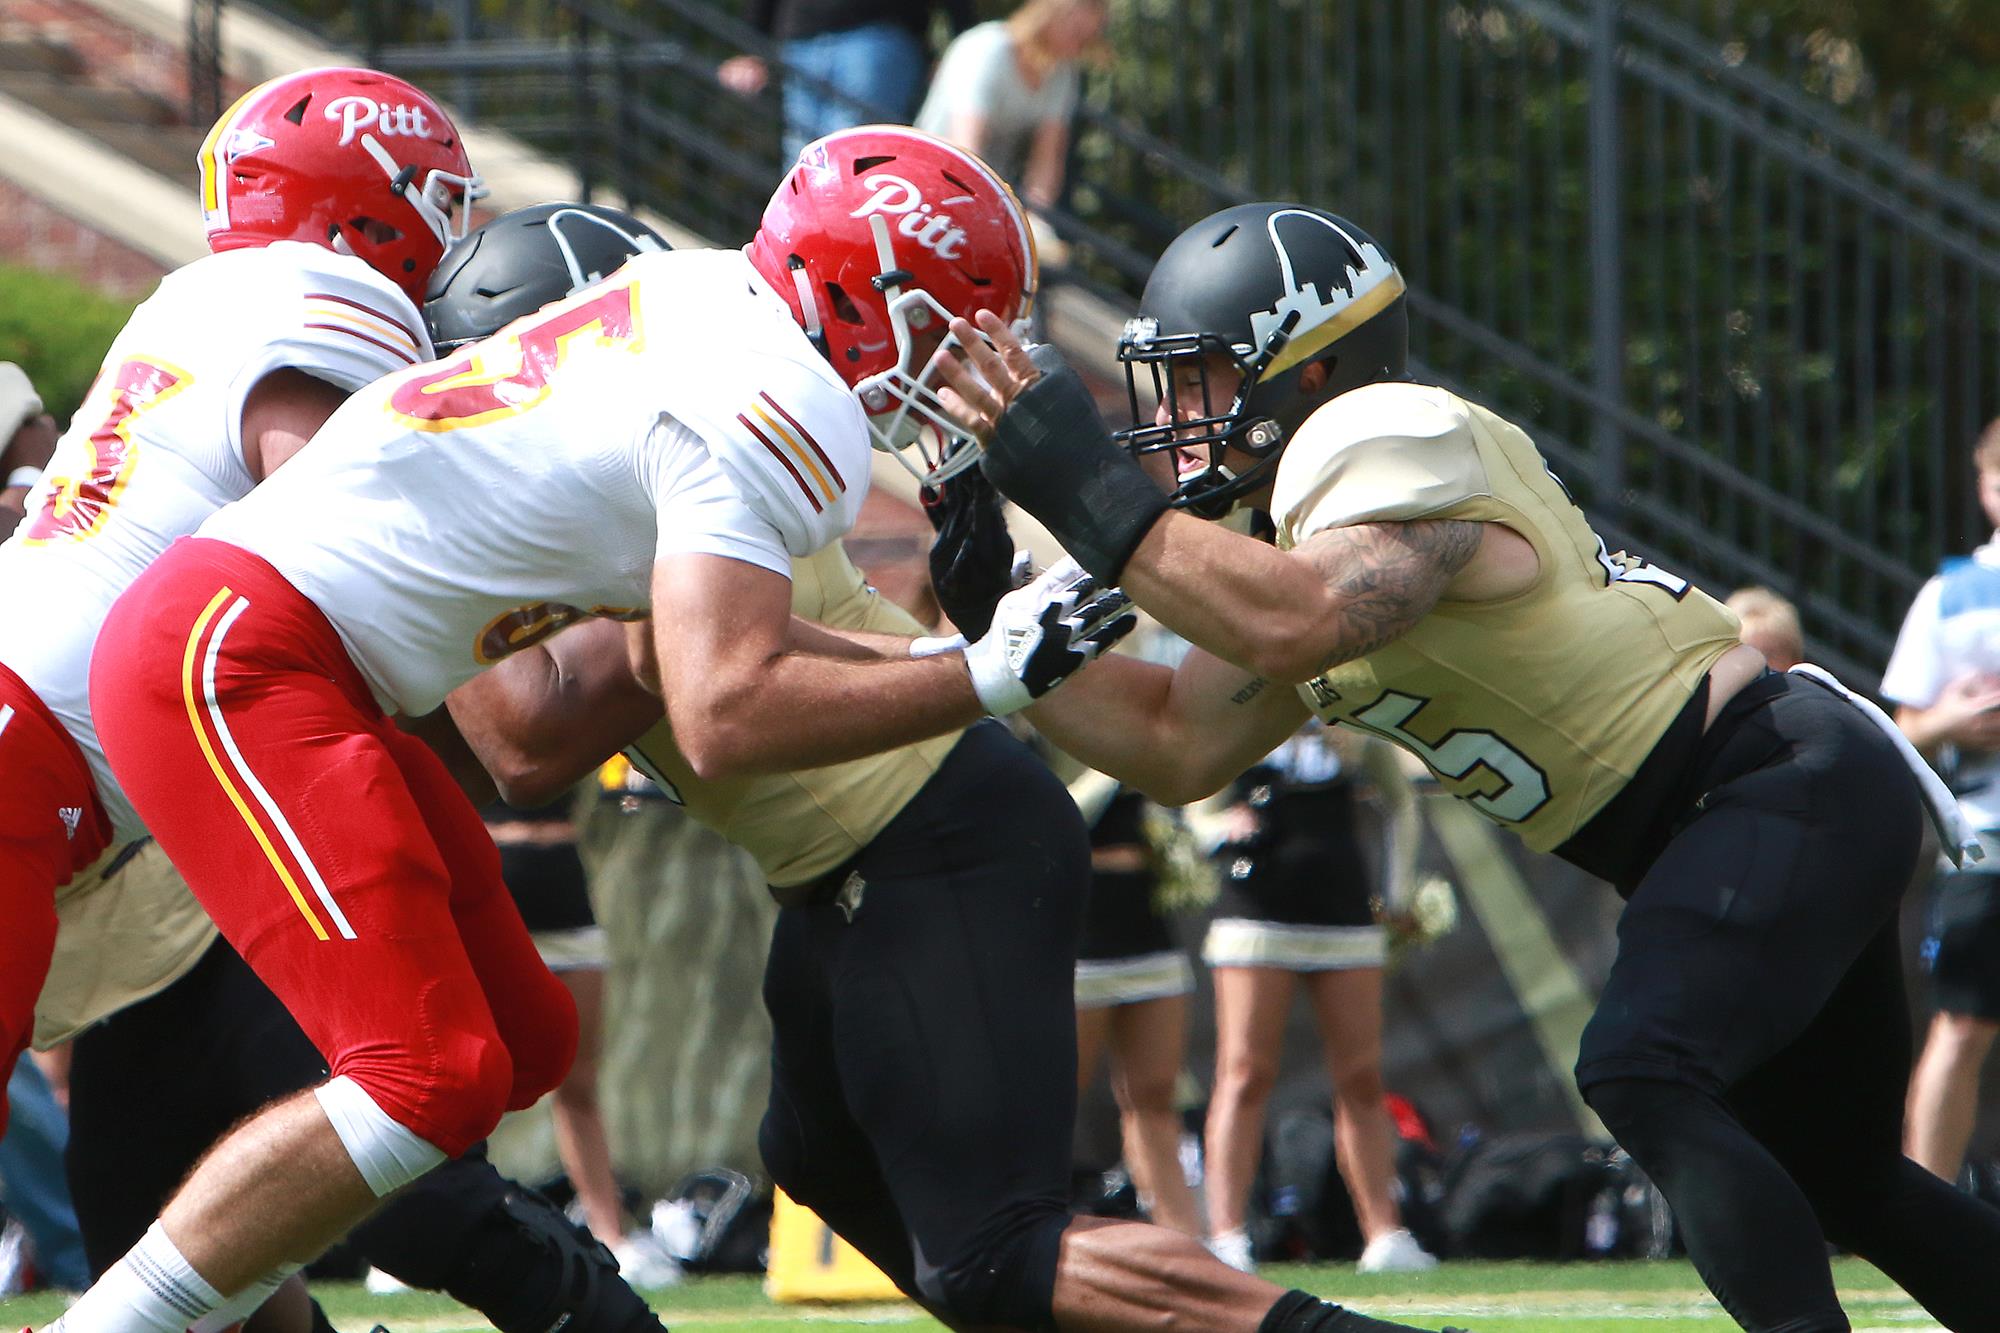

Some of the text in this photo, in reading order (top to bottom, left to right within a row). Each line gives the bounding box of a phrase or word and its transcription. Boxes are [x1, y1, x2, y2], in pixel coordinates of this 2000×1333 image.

[323, 95, 433, 147] Pitt
[849, 173, 975, 260] Pitt
[384, 280, 646, 433] 5
[1327, 688, 1554, 827] 5
